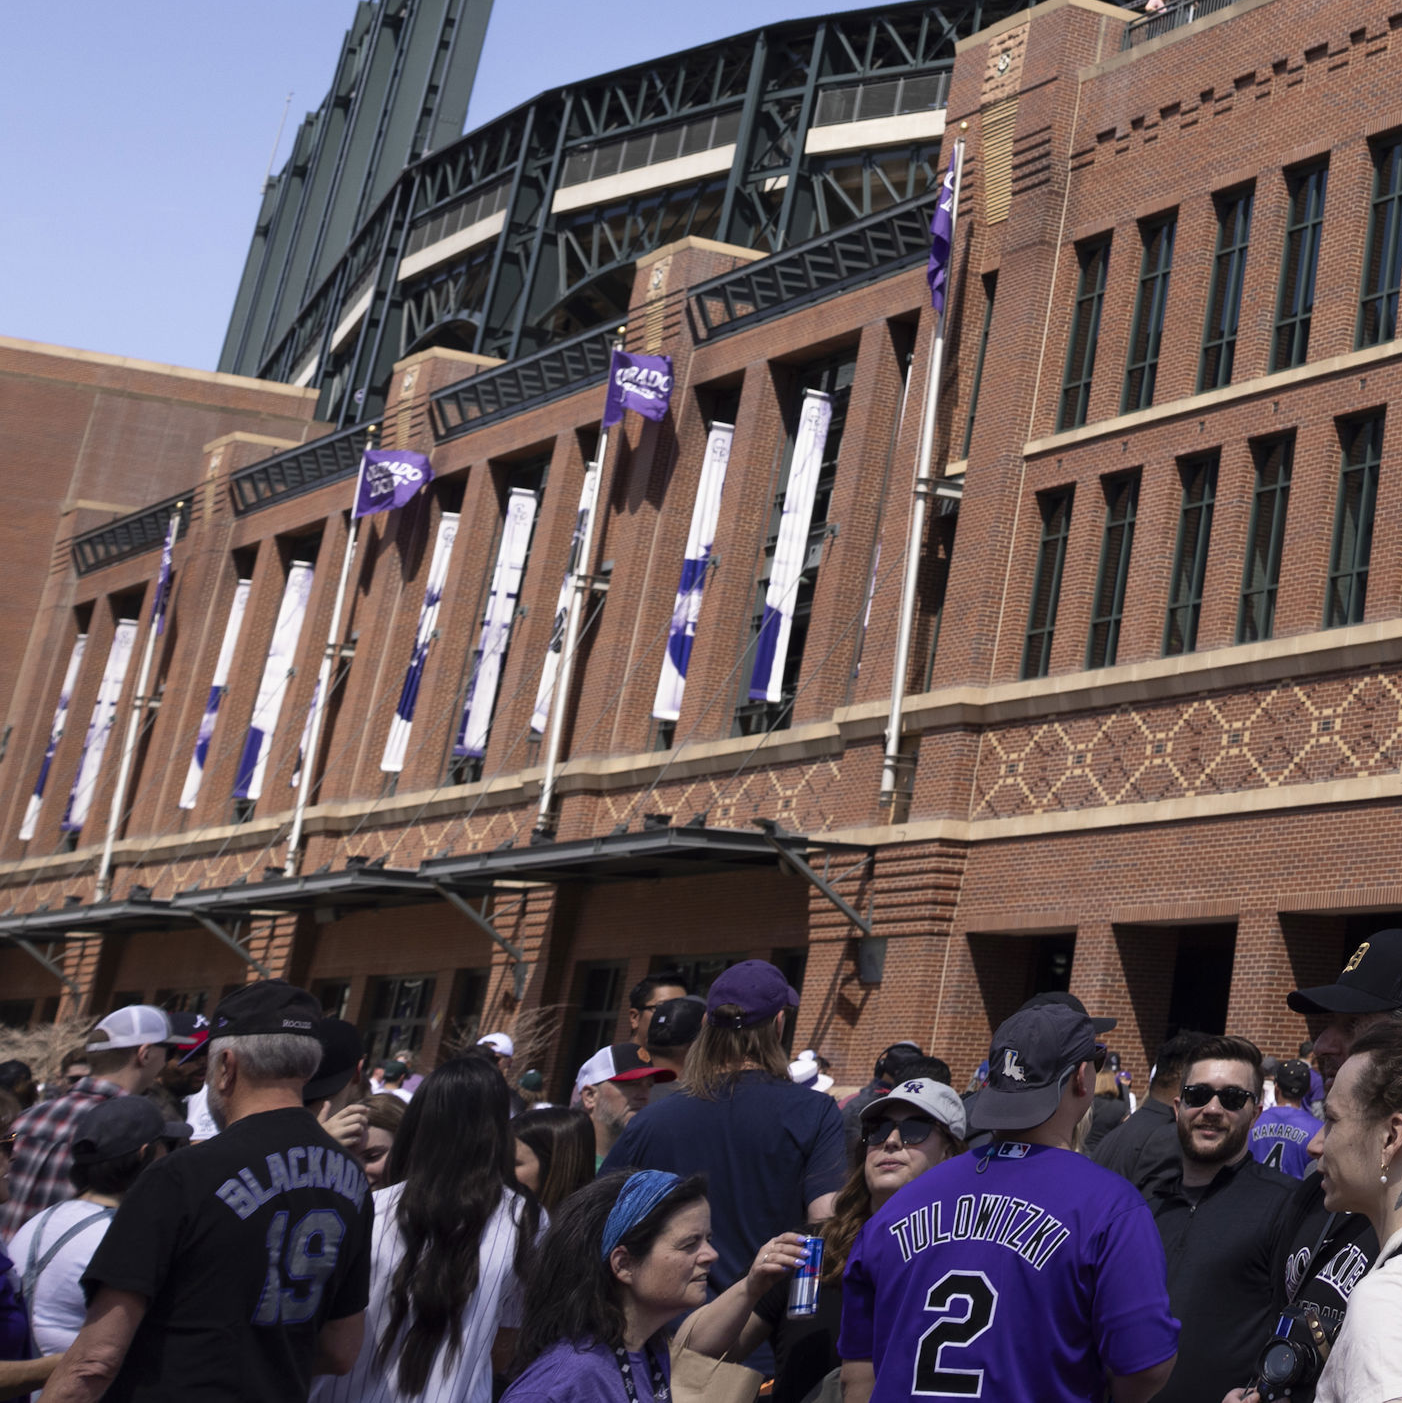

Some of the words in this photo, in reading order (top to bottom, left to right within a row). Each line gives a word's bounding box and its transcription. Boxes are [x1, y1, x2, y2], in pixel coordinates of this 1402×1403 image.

[903, 1081, 924, 1094] CR
[1252, 1123, 1309, 1145] KAKAROT
[1262, 1141, 1286, 1172] 4
[889, 1193, 1071, 1272] TULOWITZKI
[252, 1208, 347, 1326] 19
[911, 1269, 999, 1398] 2
